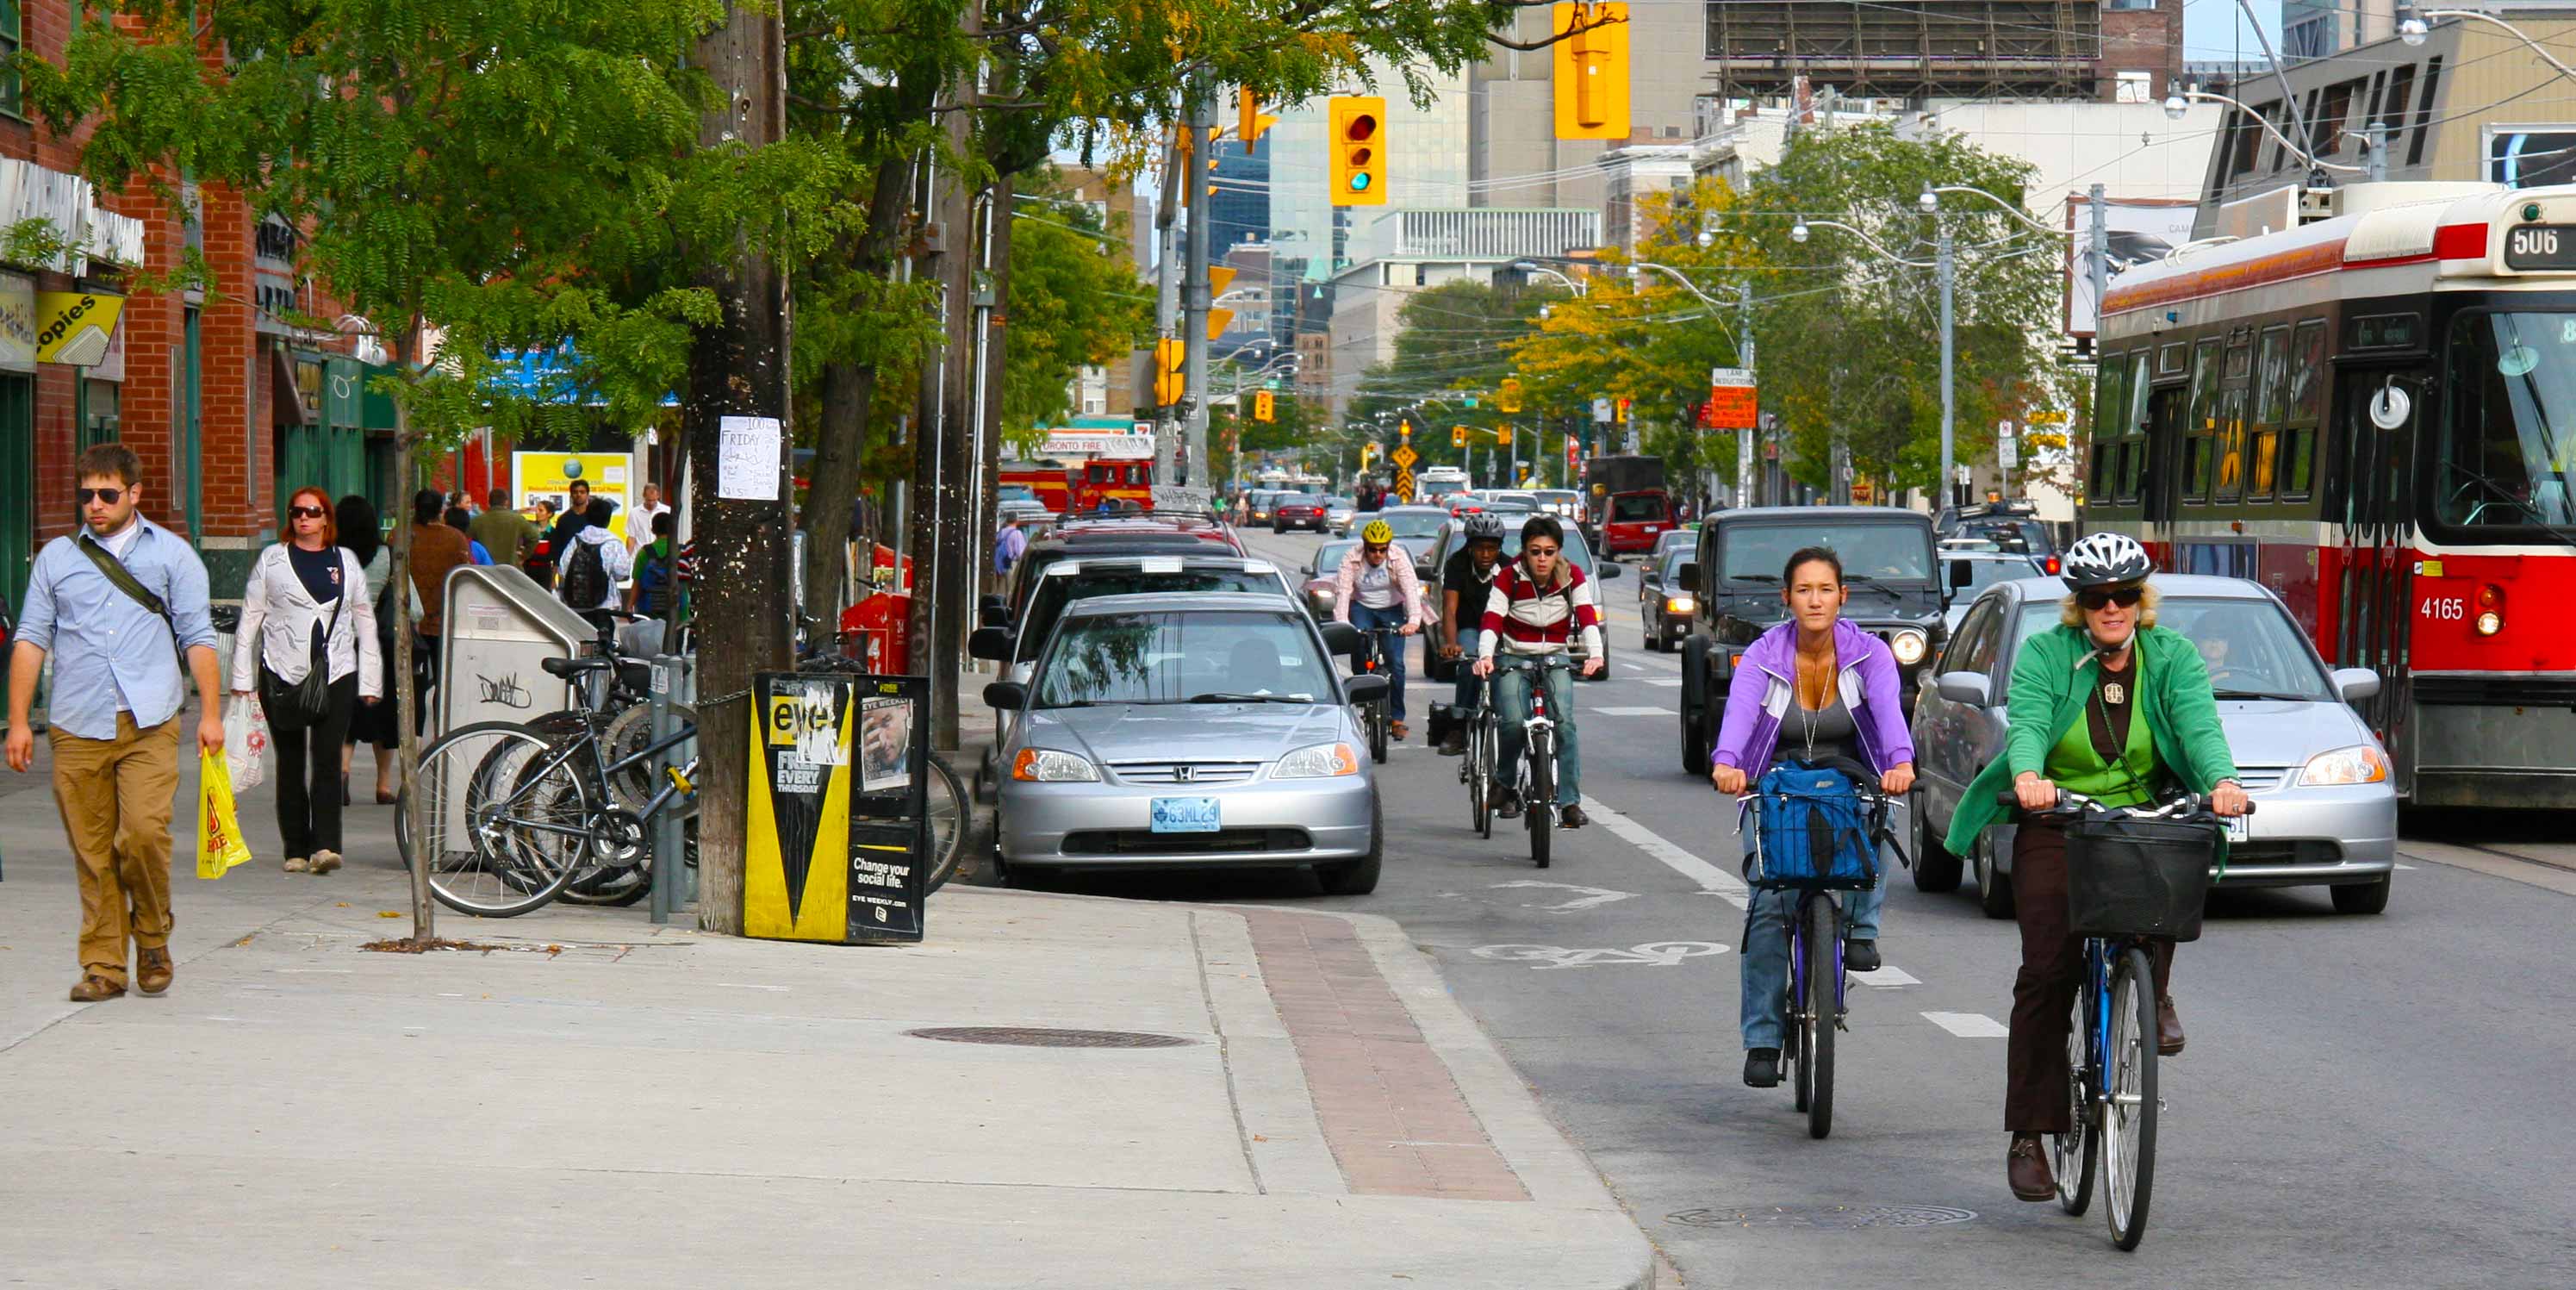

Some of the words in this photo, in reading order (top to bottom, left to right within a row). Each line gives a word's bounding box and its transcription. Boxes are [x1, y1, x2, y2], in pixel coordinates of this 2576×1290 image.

[2168, 224, 2192, 234] CAM
[2514, 229, 2558, 255] 506
[37, 296, 96, 354] opies
[721, 430, 759, 446] FRIDAY
[1042, 440, 1080, 451] ORONTO
[1082, 440, 1102, 451] FIRE
[2421, 597, 2463, 620] 4165
[879, 683, 898, 693] FREE
[862, 701, 878, 711] EYE
[777, 770, 819, 784] EVERY
[777, 784, 819, 794] THURSDAY
[853, 857, 889, 876] Change
[890, 864, 910, 876] your
[857, 873, 885, 886] social
[887, 874, 903, 888] life.
